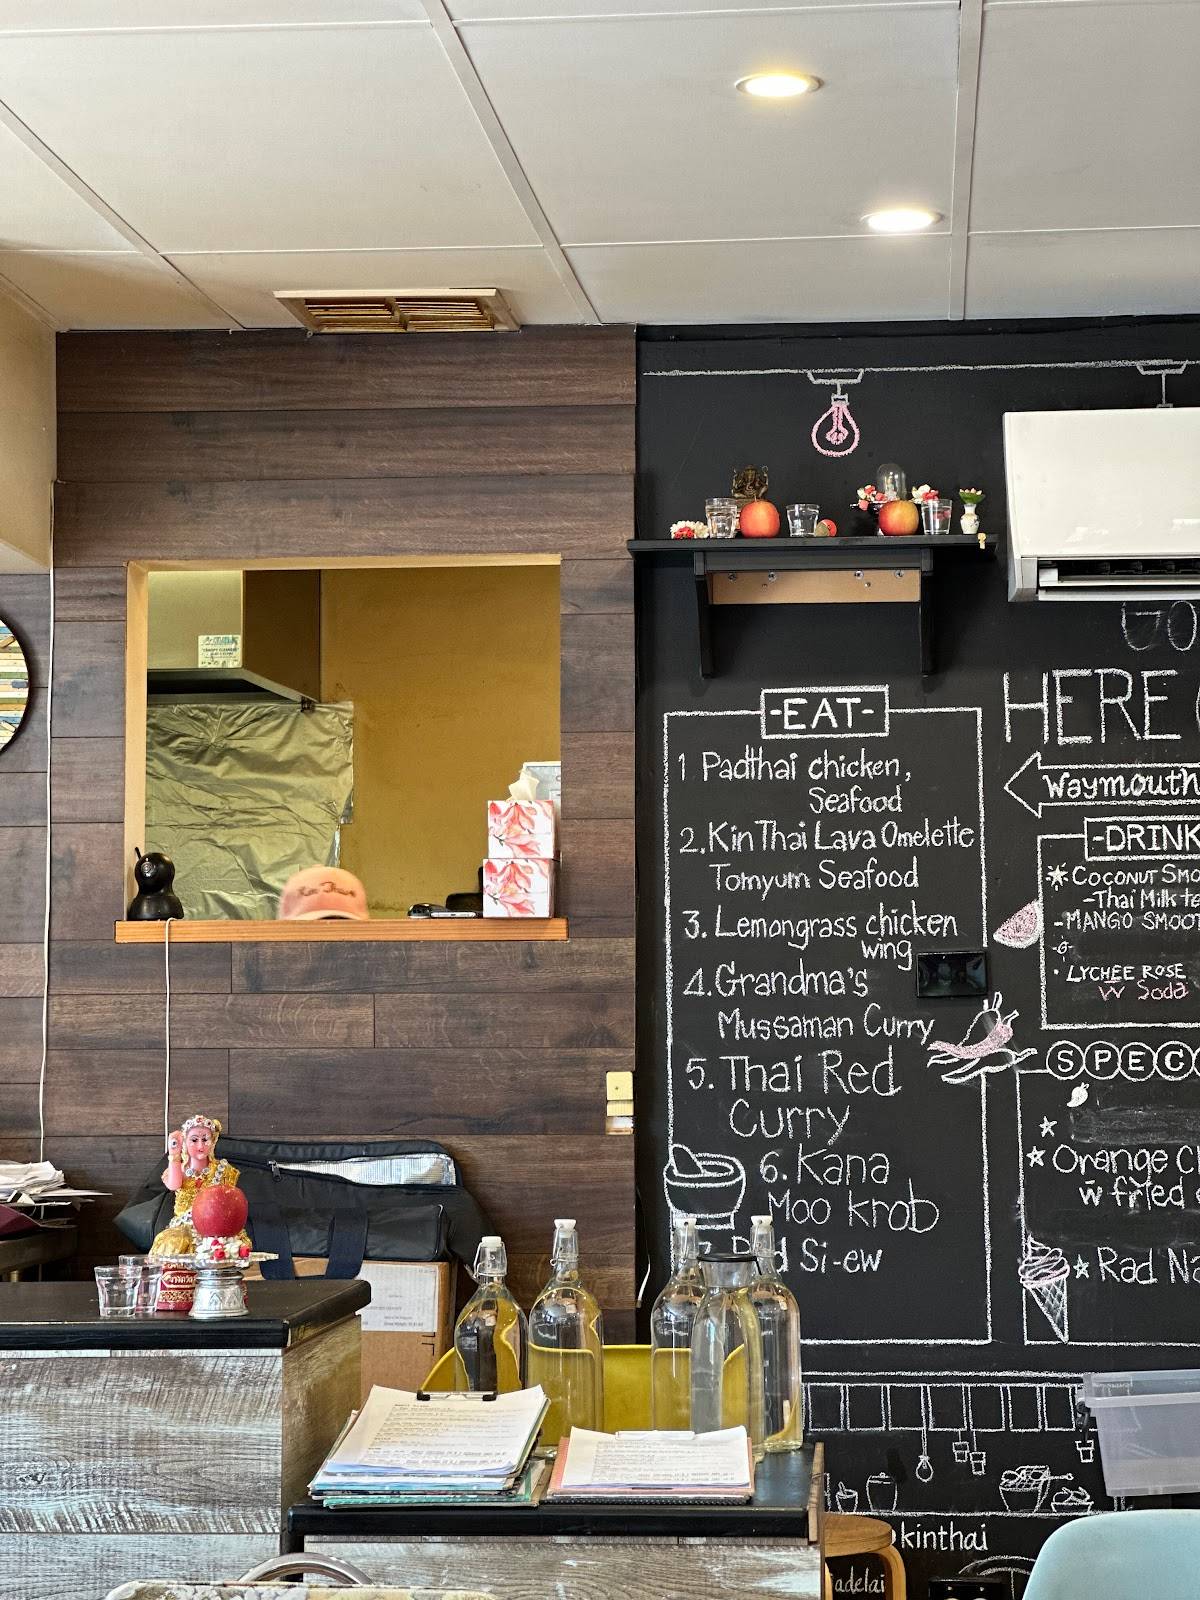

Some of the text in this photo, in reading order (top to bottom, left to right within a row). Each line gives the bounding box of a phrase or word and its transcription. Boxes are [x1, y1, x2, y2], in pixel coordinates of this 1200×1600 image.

[770, 697, 874, 730] -EAT-
[1003, 668, 1182, 745] HERE
[678, 744, 911, 782] 1 Padthai chicken,
[809, 784, 903, 814] Seafood
[1041, 768, 1200, 800] Waymouth
[814, 820, 877, 852] Lava
[881, 815, 976, 848] Omelette
[709, 854, 920, 900] Tomyum Seafood
[1071, 864, 1159, 887] COCONUT
[1140, 888, 1178, 910] Milk
[681, 899, 959, 950] 3. Lemongrass chicken
[861, 939, 913, 971] wing
[1066, 963, 1187, 982] LYCHEE ROSE
[715, 957, 869, 998] Grandma's
[1136, 979, 1190, 1001] Soda
[717, 1002, 935, 1045] Mussaman Curry
[685, 1045, 902, 1096] 5. Thai Red
[728, 1098, 851, 1146] Curry
[759, 1143, 891, 1186] 6. Kana
[1052, 1143, 1169, 1187] Orange
[767, 1178, 940, 1233] Moo krob
[731, 1236, 789, 1273] Pd
[800, 1236, 884, 1273] Si-ew
[1096, 1246, 1160, 1286] Rad
[900, 1519, 990, 1551] kinthai
[831, 1565, 886, 1595] adelai
